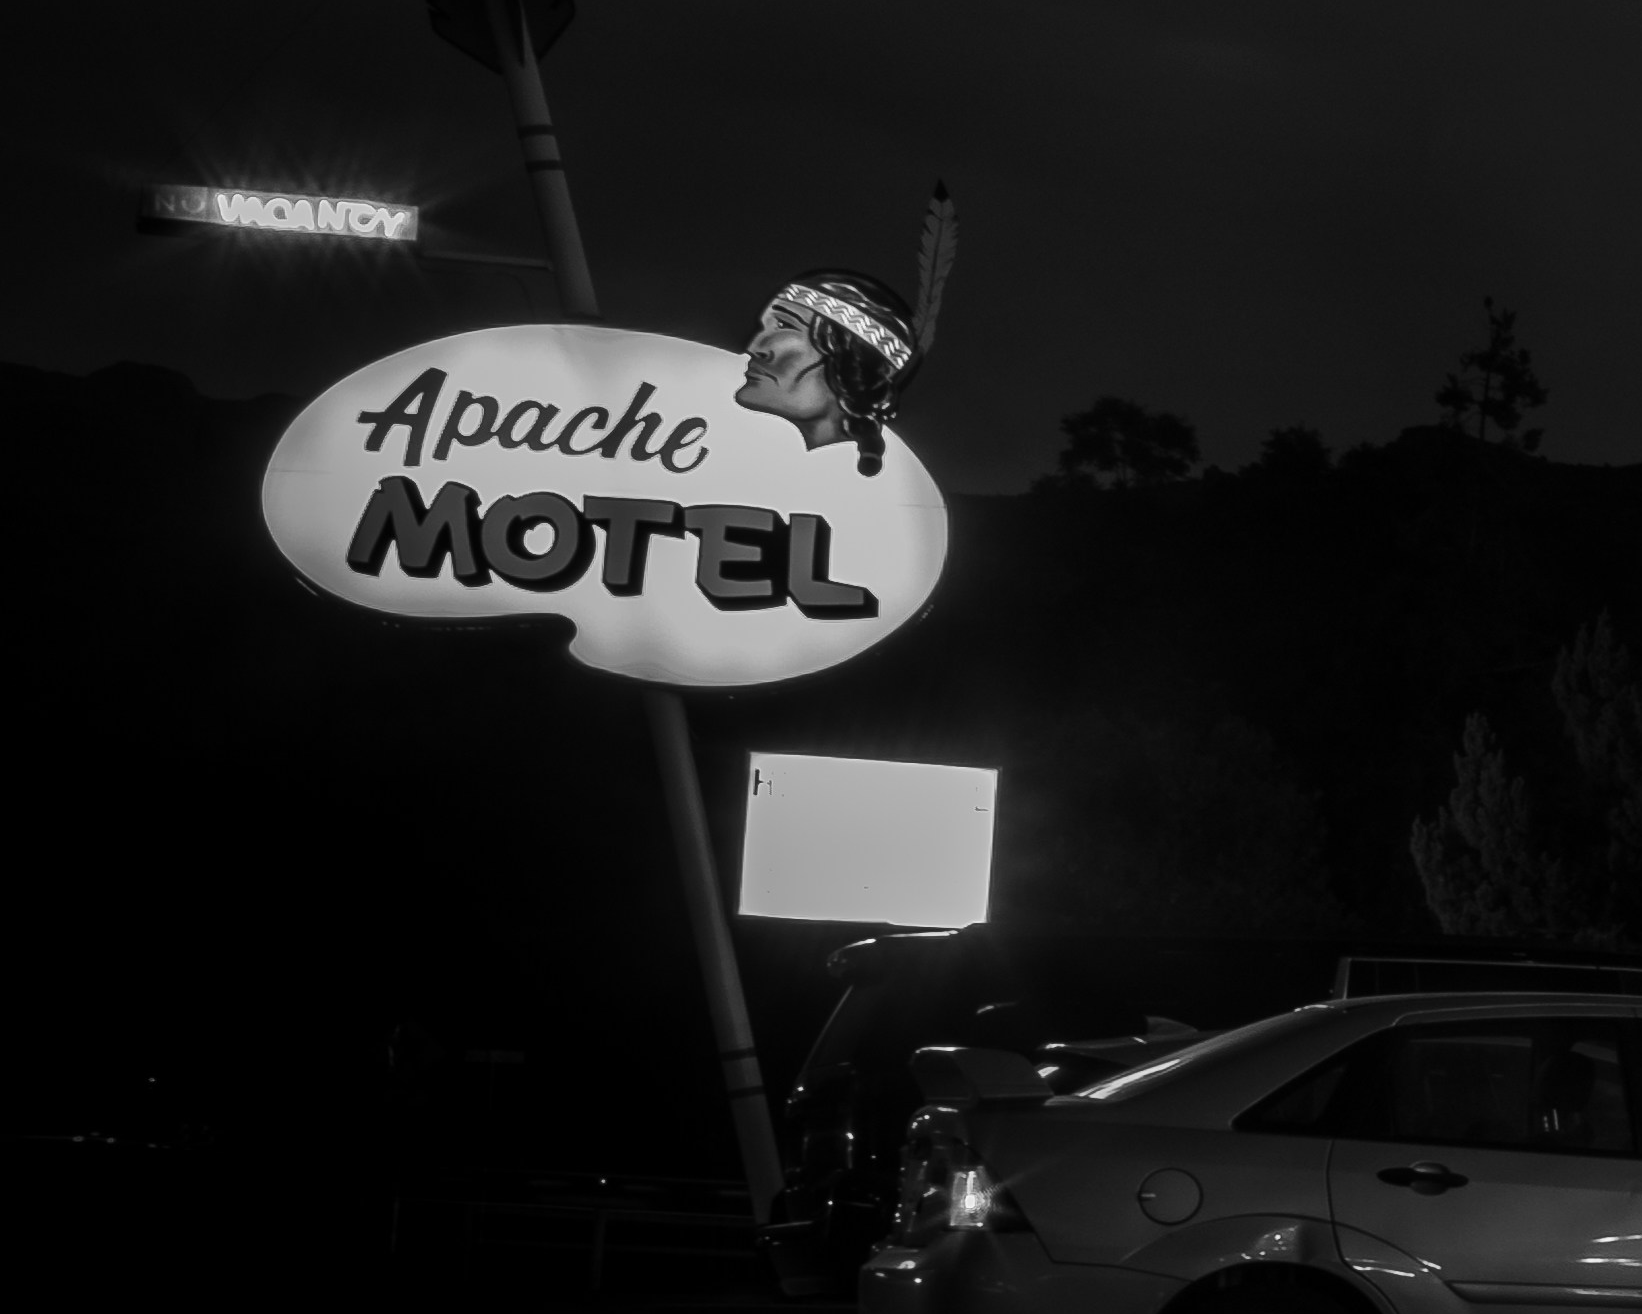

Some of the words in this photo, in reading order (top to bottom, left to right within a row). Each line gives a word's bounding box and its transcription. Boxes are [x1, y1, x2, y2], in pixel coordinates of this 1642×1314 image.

[217, 193, 406, 237] VACANCY
[357, 367, 709, 474] Apache
[347, 475, 879, 621] MOTEL
